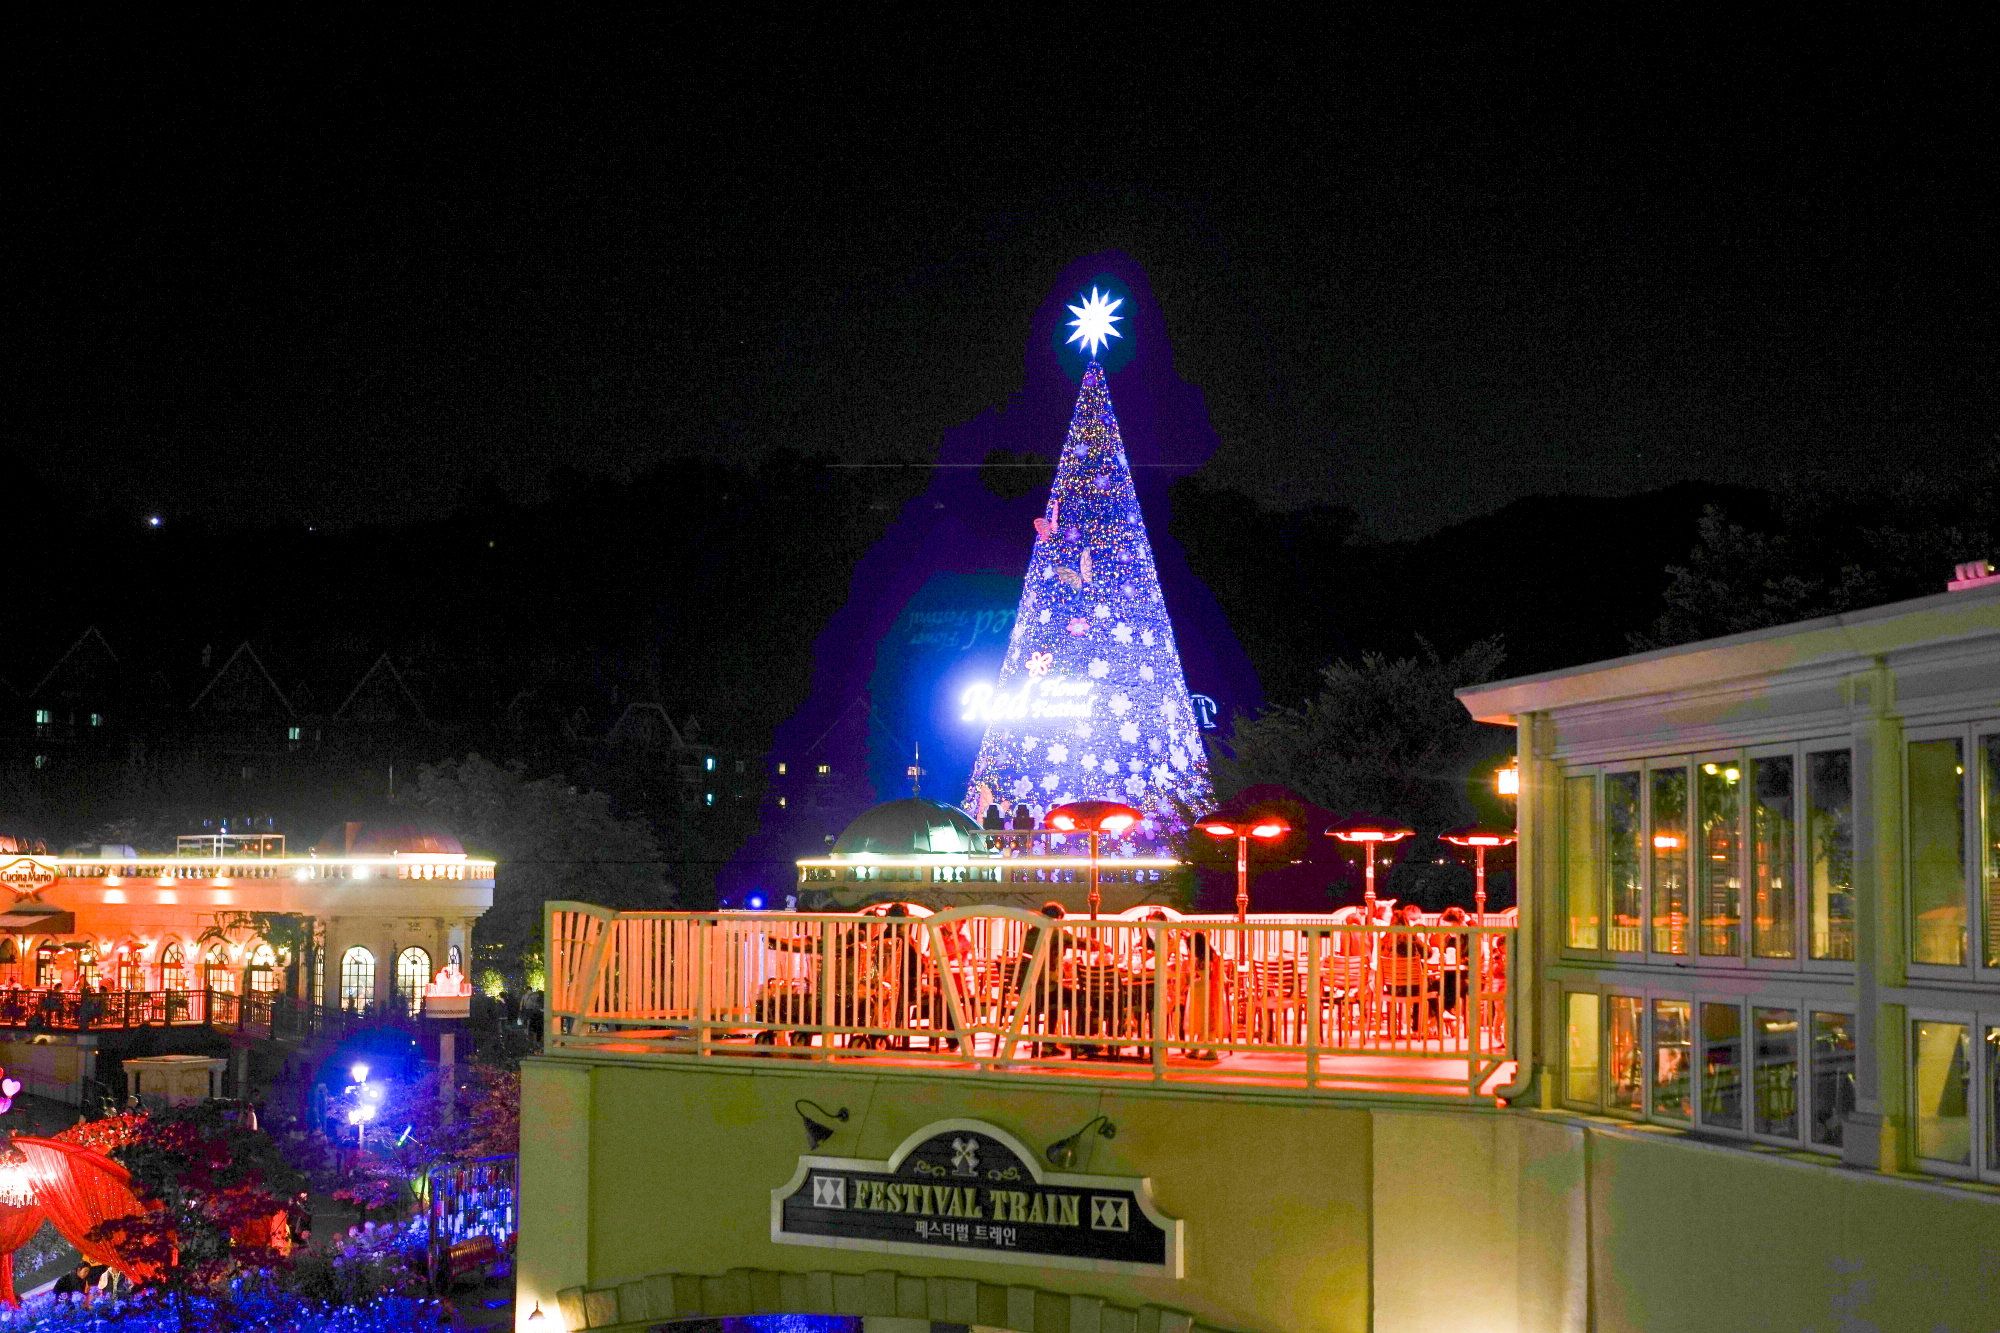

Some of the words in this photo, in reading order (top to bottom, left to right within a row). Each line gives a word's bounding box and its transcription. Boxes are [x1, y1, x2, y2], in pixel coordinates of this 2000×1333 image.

[962, 677, 1042, 720] Red
[1, 870, 27, 882] Cucina
[28, 870, 52, 882] Mario
[854, 1180, 983, 1219] FESTIVAL
[990, 1190, 1081, 1226] TRAIN
[915, 1220, 970, 1240] 페스티벌
[975, 1226, 1017, 1246] 트레인
